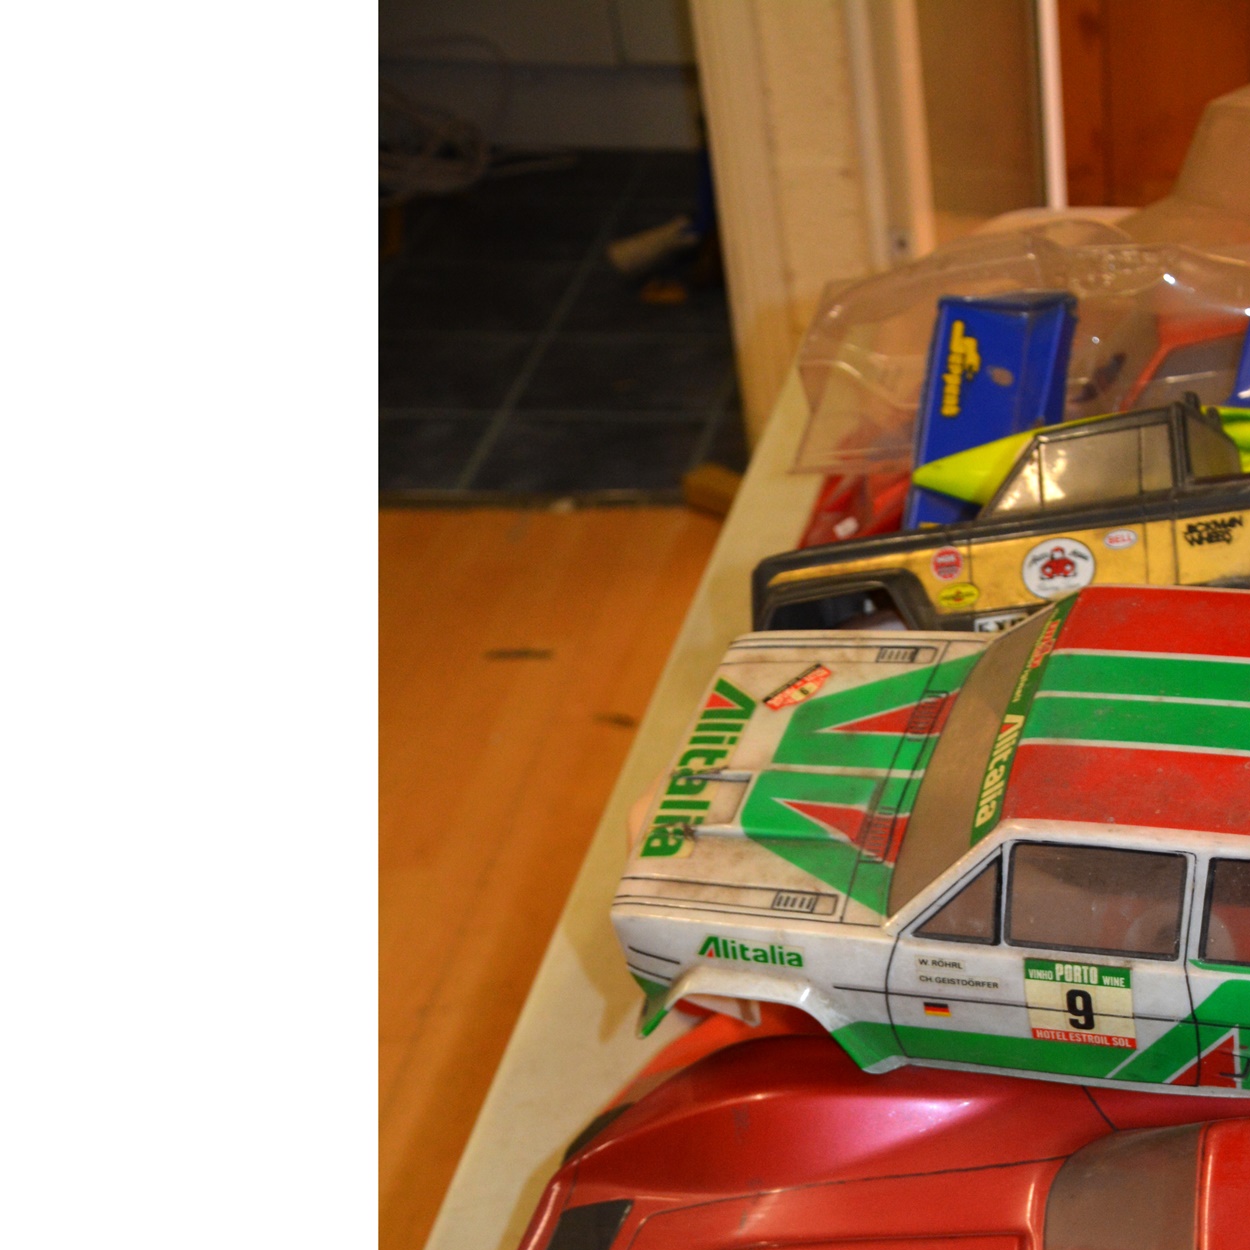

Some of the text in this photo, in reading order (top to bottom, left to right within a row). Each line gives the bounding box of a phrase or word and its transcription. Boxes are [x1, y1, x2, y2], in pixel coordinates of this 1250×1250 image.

[640, 677, 757, 857] Alitalia
[975, 714, 1025, 827] Alitalia
[698, 936, 804, 968] Alitalia
[932, 958, 963, 970] RÖHRL
[1028, 963, 1125, 987] VINHO PORTO WINE
[1066, 989, 1095, 1030] 9
[1036, 1029, 1132, 1048] HOTEL ESTROIL SOL
